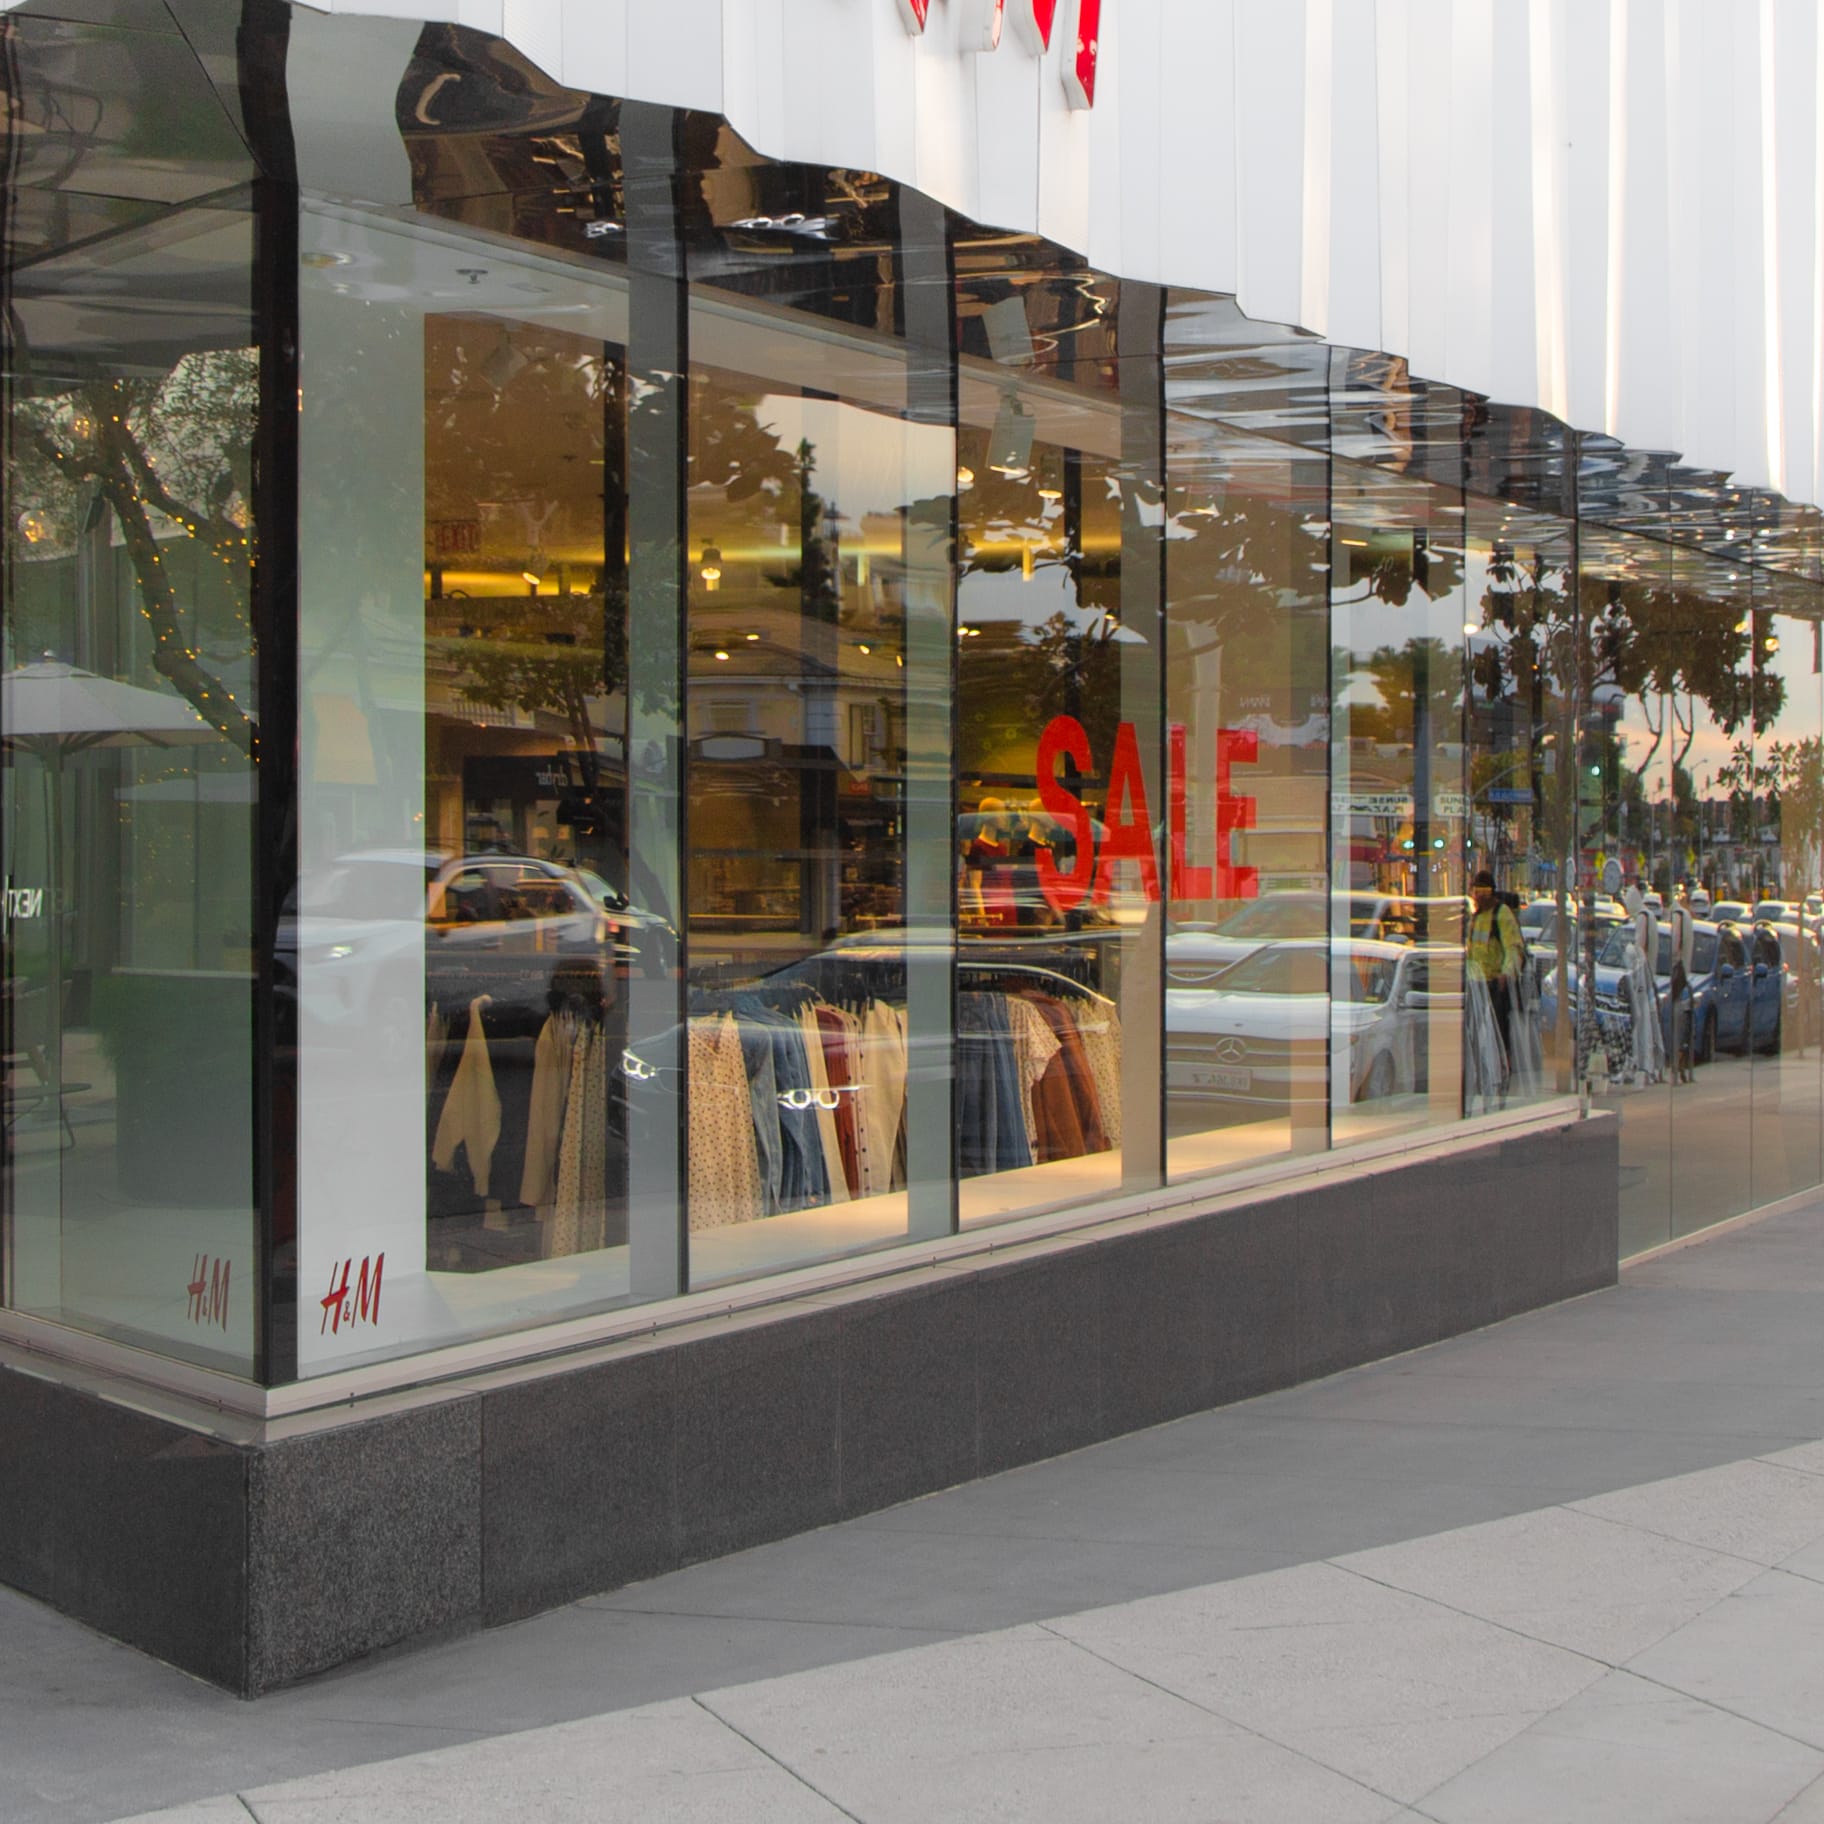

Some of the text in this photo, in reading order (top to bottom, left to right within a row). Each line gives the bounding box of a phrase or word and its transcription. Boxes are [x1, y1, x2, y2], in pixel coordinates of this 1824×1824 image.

[1034, 715, 1259, 911] SALE
[187, 1252, 231, 1333] H&M
[320, 1252, 385, 1336] H&M
